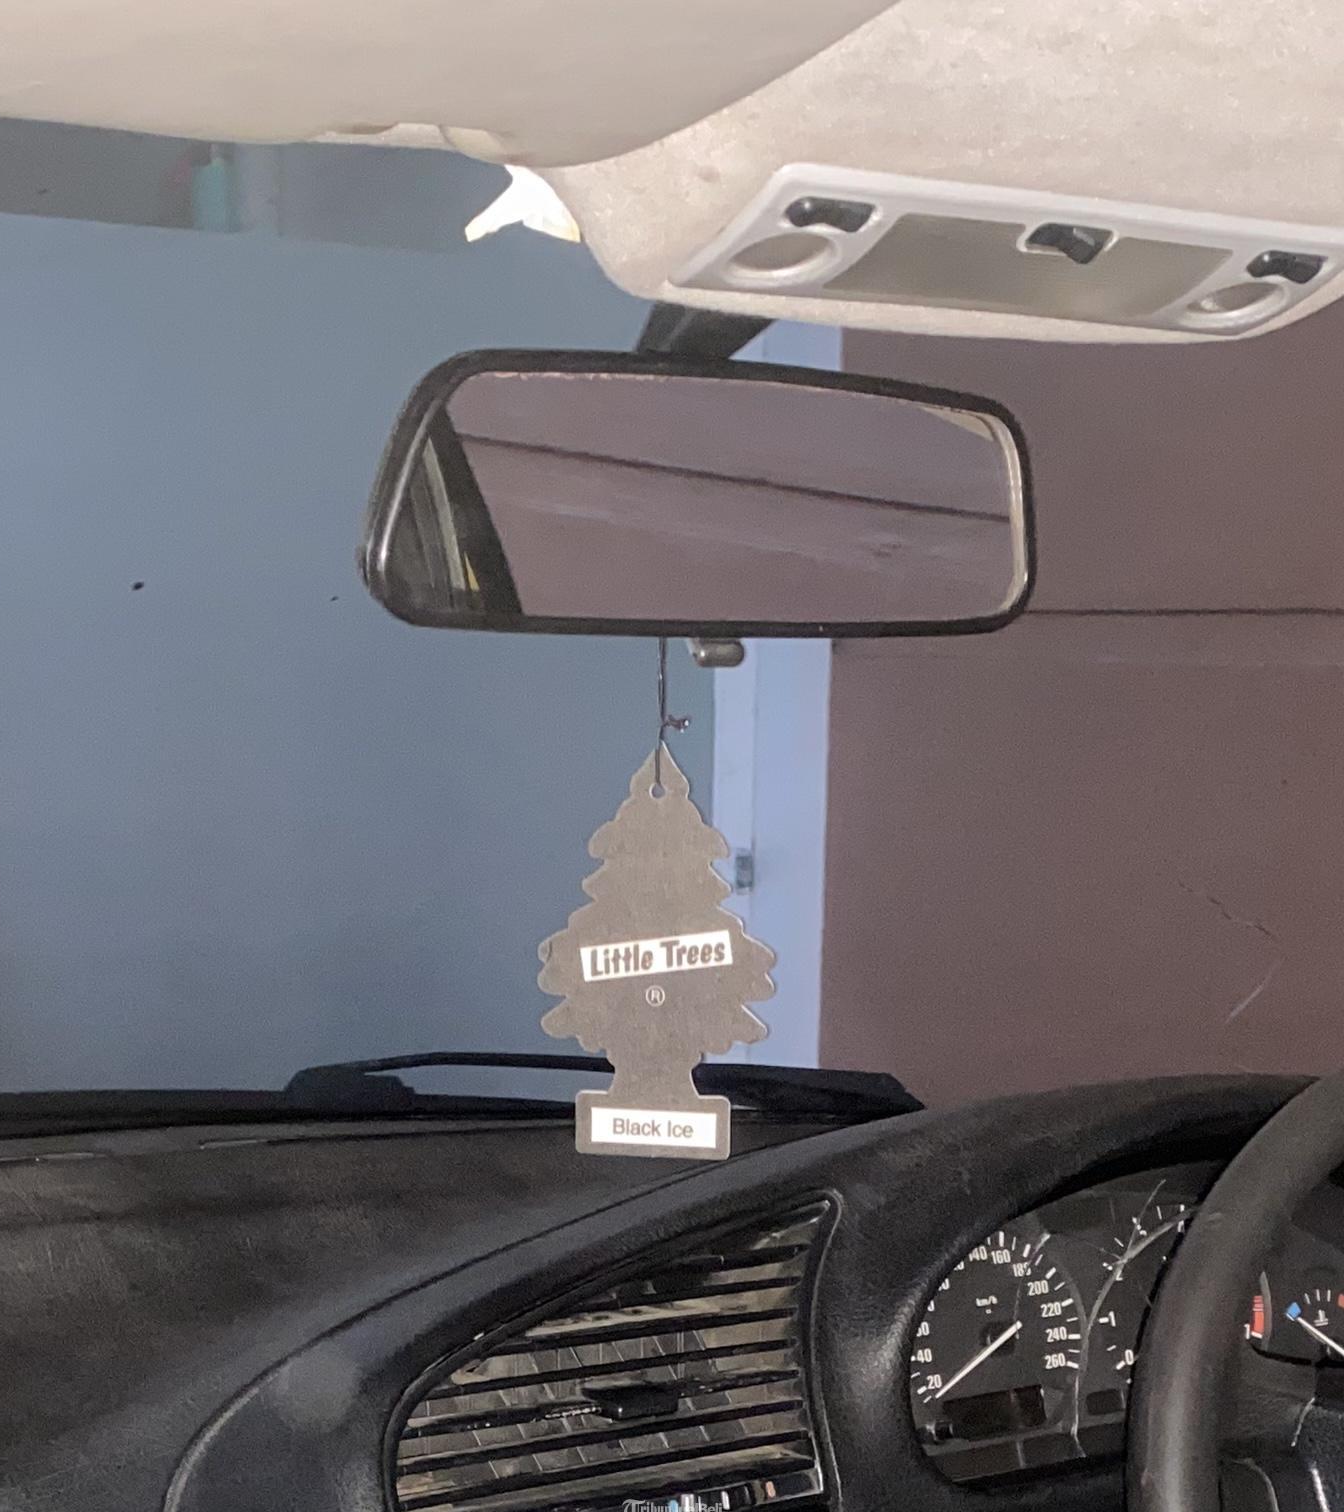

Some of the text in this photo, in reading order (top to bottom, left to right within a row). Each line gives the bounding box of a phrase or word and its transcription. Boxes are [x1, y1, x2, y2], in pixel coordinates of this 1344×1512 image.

[589, 938, 726, 977] Little Trees
[612, 1117, 694, 1139] Black Ice
[991, 1249, 1011, 1265] 160
[1027, 1280, 1049, 1296] 200
[1040, 1302, 1062, 1317] 220
[1046, 1326, 1068, 1343] 240
[916, 1348, 933, 1363] 40
[1045, 1353, 1066, 1369] 260
[927, 1374, 943, 1390] 20
